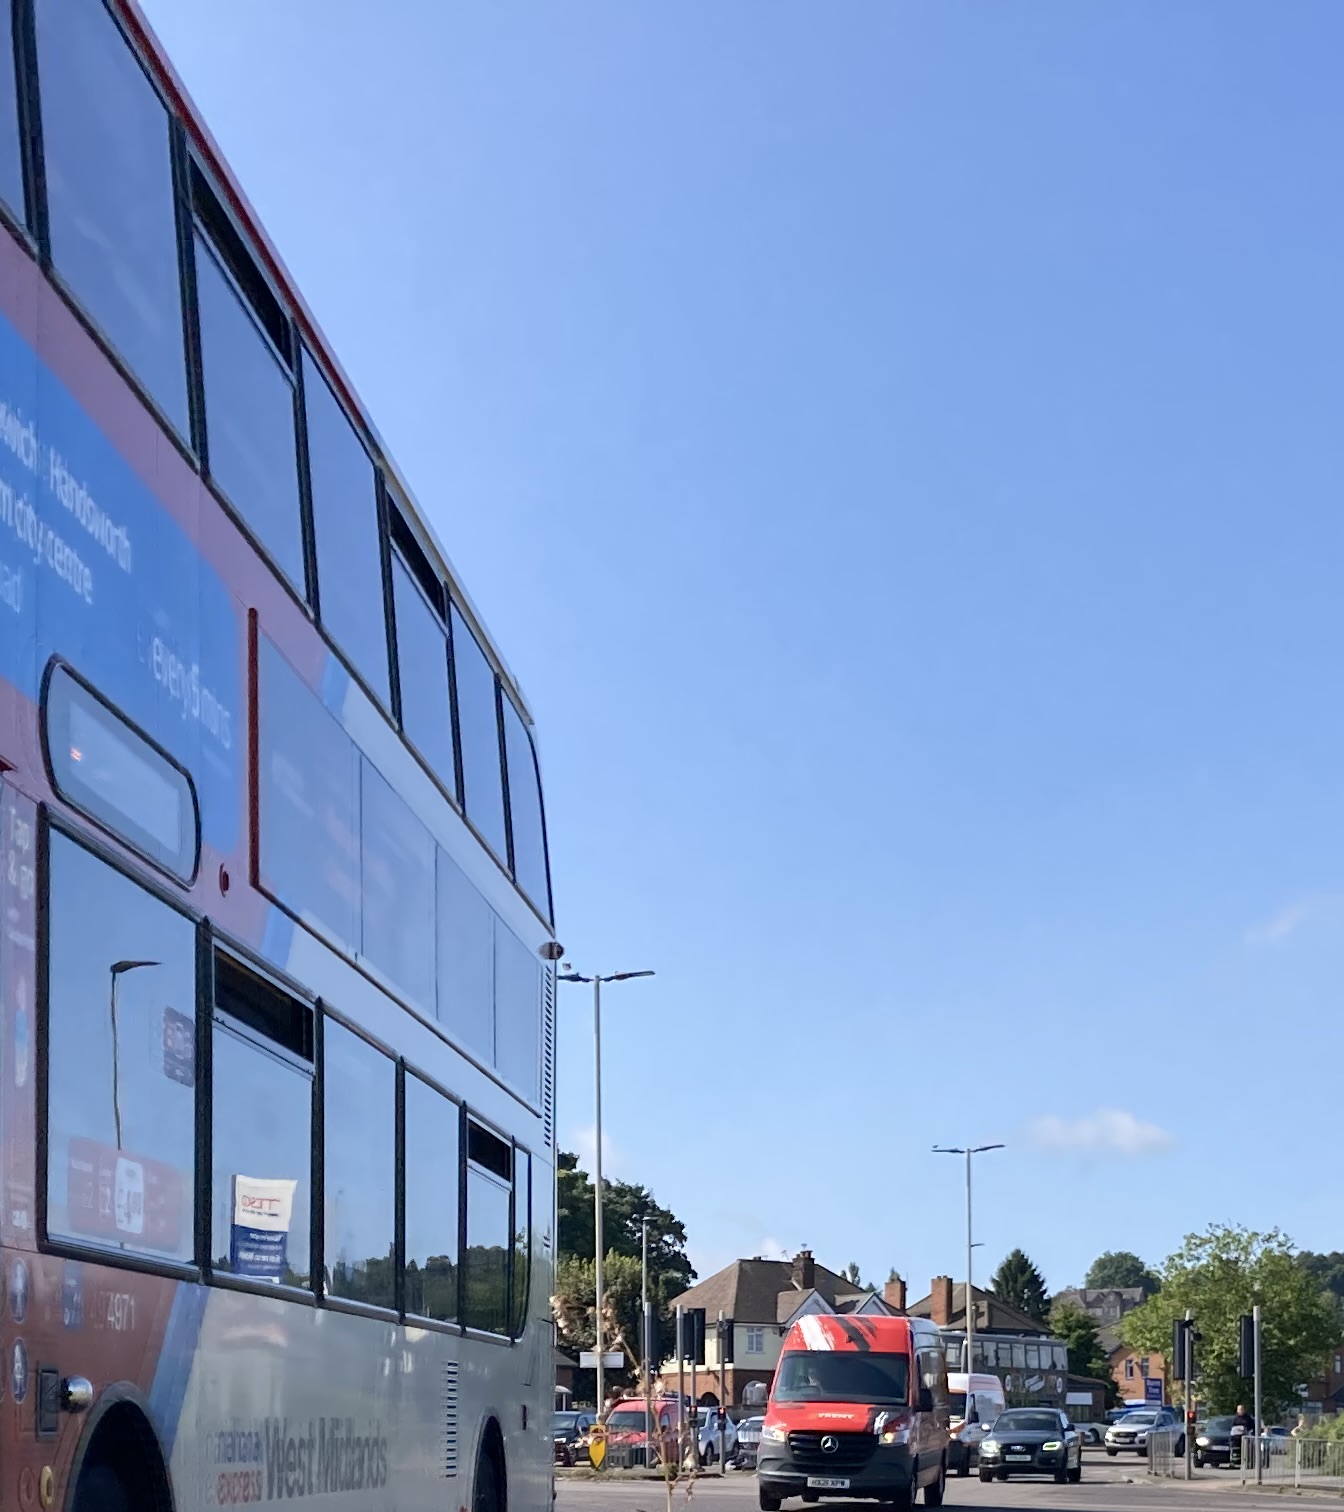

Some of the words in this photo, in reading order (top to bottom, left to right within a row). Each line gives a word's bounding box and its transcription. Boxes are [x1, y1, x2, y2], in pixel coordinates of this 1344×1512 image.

[14, 492, 42, 565] city
[46, 528, 94, 605] centre
[49, 447, 133, 574] Handsworth
[152, 636, 188, 720] every
[106, 1293, 136, 1331] 4971
[264, 1417, 316, 1501] West
[317, 1416, 388, 1494] Midlands
